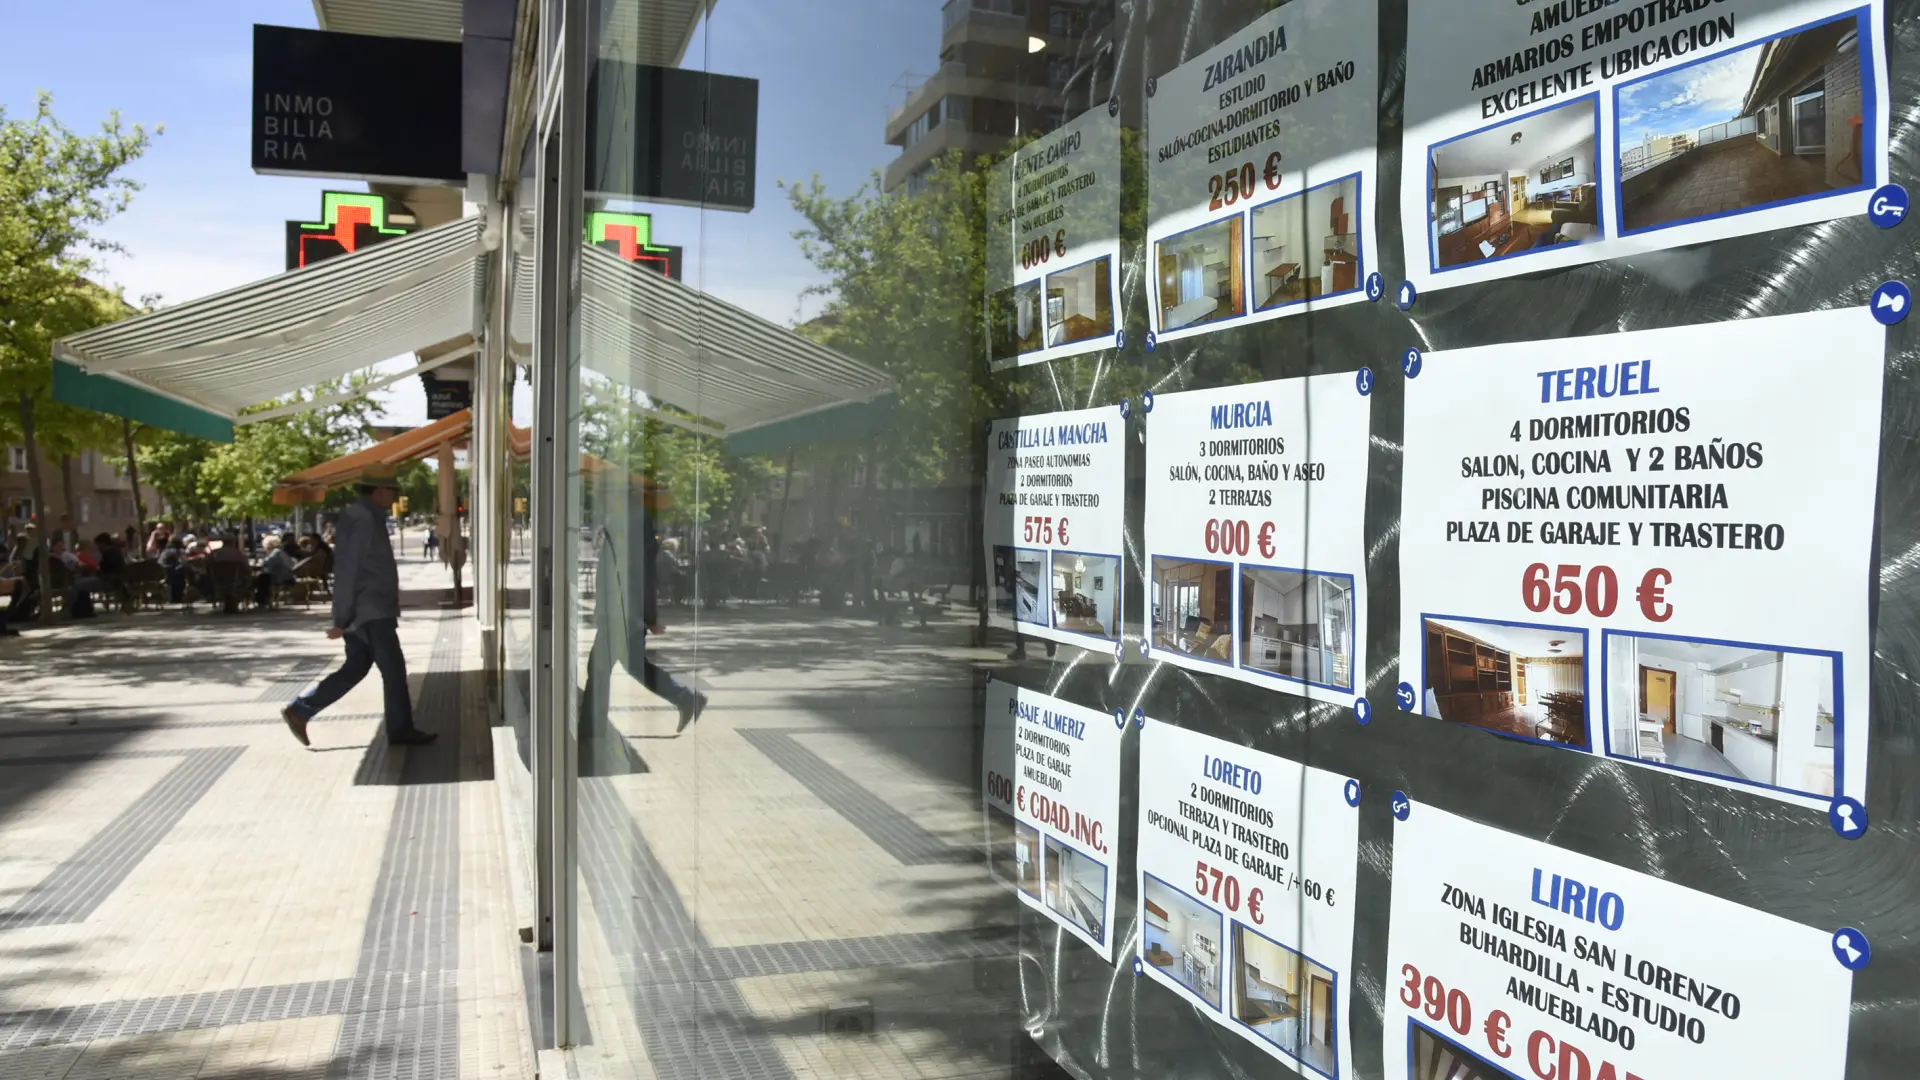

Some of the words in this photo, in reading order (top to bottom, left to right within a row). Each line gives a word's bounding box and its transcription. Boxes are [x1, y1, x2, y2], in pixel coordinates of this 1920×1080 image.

[1203, 25, 1287, 92] ZARANDIA
[1471, 34, 1574, 91] ARMARIOS
[1582, 0, 1727, 51] EMPOTRA
[1482, 62, 1594, 120] EXCELENTE
[1601, 12, 1735, 80] UBICACION
[265, 92, 333, 116] INMO
[1219, 74, 1265, 110] ESTUDIO
[264, 116, 333, 140] BILIA
[1159, 84, 1300, 163] SALÓN-COCINA-DORMITORIO
[1304, 77, 1312, 98] Y
[1317, 60, 1355, 93] BAÑO
[264, 140, 306, 160] RIA
[1047, 131, 1081, 164] CAMPO
[1208, 119, 1281, 164] ESTUDIANTES
[1023, 162, 1069, 197] DORMITORIOS
[1057, 171, 1096, 199] TRASTERO
[1208, 161, 1255, 211] 250
[1263, 151, 1282, 191] €
[1054, 228, 1066, 257] €
[1537, 359, 1659, 403] TERUEL
[1210, 400, 1272, 429] MURCIA
[1510, 420, 1521, 442] 4
[1529, 407, 1690, 441] DORMITORIOS
[998, 428, 1039, 450] CASTILLA
[1043, 426, 1055, 447] LA
[1058, 422, 1107, 446] MANCHA
[1200, 441, 1206, 456] 3
[1209, 437, 1284, 457] DORMITORIOS
[1007, 456, 1022, 469] ZONA
[1024, 455, 1044, 468] PASEO
[1046, 453, 1091, 468] AUTONOMIAS
[1169, 462, 1201, 483] SALÓN,
[1205, 464, 1244, 484] COCINA,
[1248, 460, 1278, 481] BAÑO
[1282, 463, 1290, 481] Y
[1293, 463, 1325, 481] ASEO
[1461, 455, 1525, 479] SALON,
[1532, 450, 1612, 475] COCINA
[1626, 448, 1641, 472] Y
[1649, 447, 1664, 471] 2
[1674, 437, 1763, 470] BAÑOS
[1020, 475, 1025, 487] 2
[1027, 474, 1073, 487] DORMITORIOS
[1209, 489, 1215, 505] 2
[1219, 489, 1272, 507] TERRAZAS
[1482, 487, 1560, 510] PISCINA
[1566, 483, 1728, 509] COMUNITARIA
[1000, 493, 1017, 505] PLAZA
[1019, 493, 1028, 506] DE
[1030, 493, 1053, 506] GARAJE
[1055, 494, 1060, 506] Y
[1061, 493, 1100, 507] TRASTERO
[1024, 516, 1052, 544] 575
[1058, 517, 1070, 545] €
[1205, 518, 1250, 556] 600
[1257, 521, 1276, 559] €
[1446, 521, 1500, 543] PLAZA
[1507, 522, 1533, 544] DE
[1540, 522, 1620, 545] GARAJE
[1628, 523, 1643, 546] Y
[1650, 523, 1785, 551] TRASTERO
[1522, 562, 1618, 618] 650
[1636, 567, 1673, 622] €
[1009, 698, 1040, 725] PASAJE
[1042, 709, 1086, 741] ALMERIZ
[1018, 726, 1023, 738] 2
[1024, 728, 1070, 757] DORMITORIOS
[1015, 744, 1035, 763] PLAZA
[1036, 753, 1046, 766] DE
[1047, 756, 1072, 778] GARAJE
[1023, 765, 1062, 792] AMUEBLADO
[1203, 754, 1262, 795] LORETO
[987, 771, 1013, 804] 600
[1016, 785, 1026, 812] €
[1030, 791, 1108, 854] CDAD.INC.
[1190, 782, 1197, 798] 2
[1200, 785, 1274, 829] DORMITORIOS
[1178, 800, 1220, 832] TERRAZA
[1222, 818, 1229, 835] Y
[1232, 822, 1289, 860] TRASTERO
[1148, 809, 1190, 842] OPCIONAL
[1192, 829, 1222, 857] PLAZA
[1225, 844, 1239, 865] DE
[1242, 852, 1285, 885] GARAJE
[1304, 878, 1321, 900] 60
[1325, 888, 1335, 906] €
[1195, 860, 1240, 912] 570
[1247, 887, 1264, 925] €
[1531, 867, 1624, 931] LIRIO
[1440, 882, 1486, 920] ZONA
[1492, 902, 1567, 953] IGLESIA
[1573, 935, 1616, 971] SAN
[1624, 953, 1740, 1020] LORENZO
[1459, 922, 1580, 993] BUHARDILLA
[1601, 981, 1706, 1044] ESTUDIO
[1399, 963, 1472, 1036] 390
[1484, 1009, 1511, 1059] €
[1505, 976, 1635, 1051] AMUEBLADO
